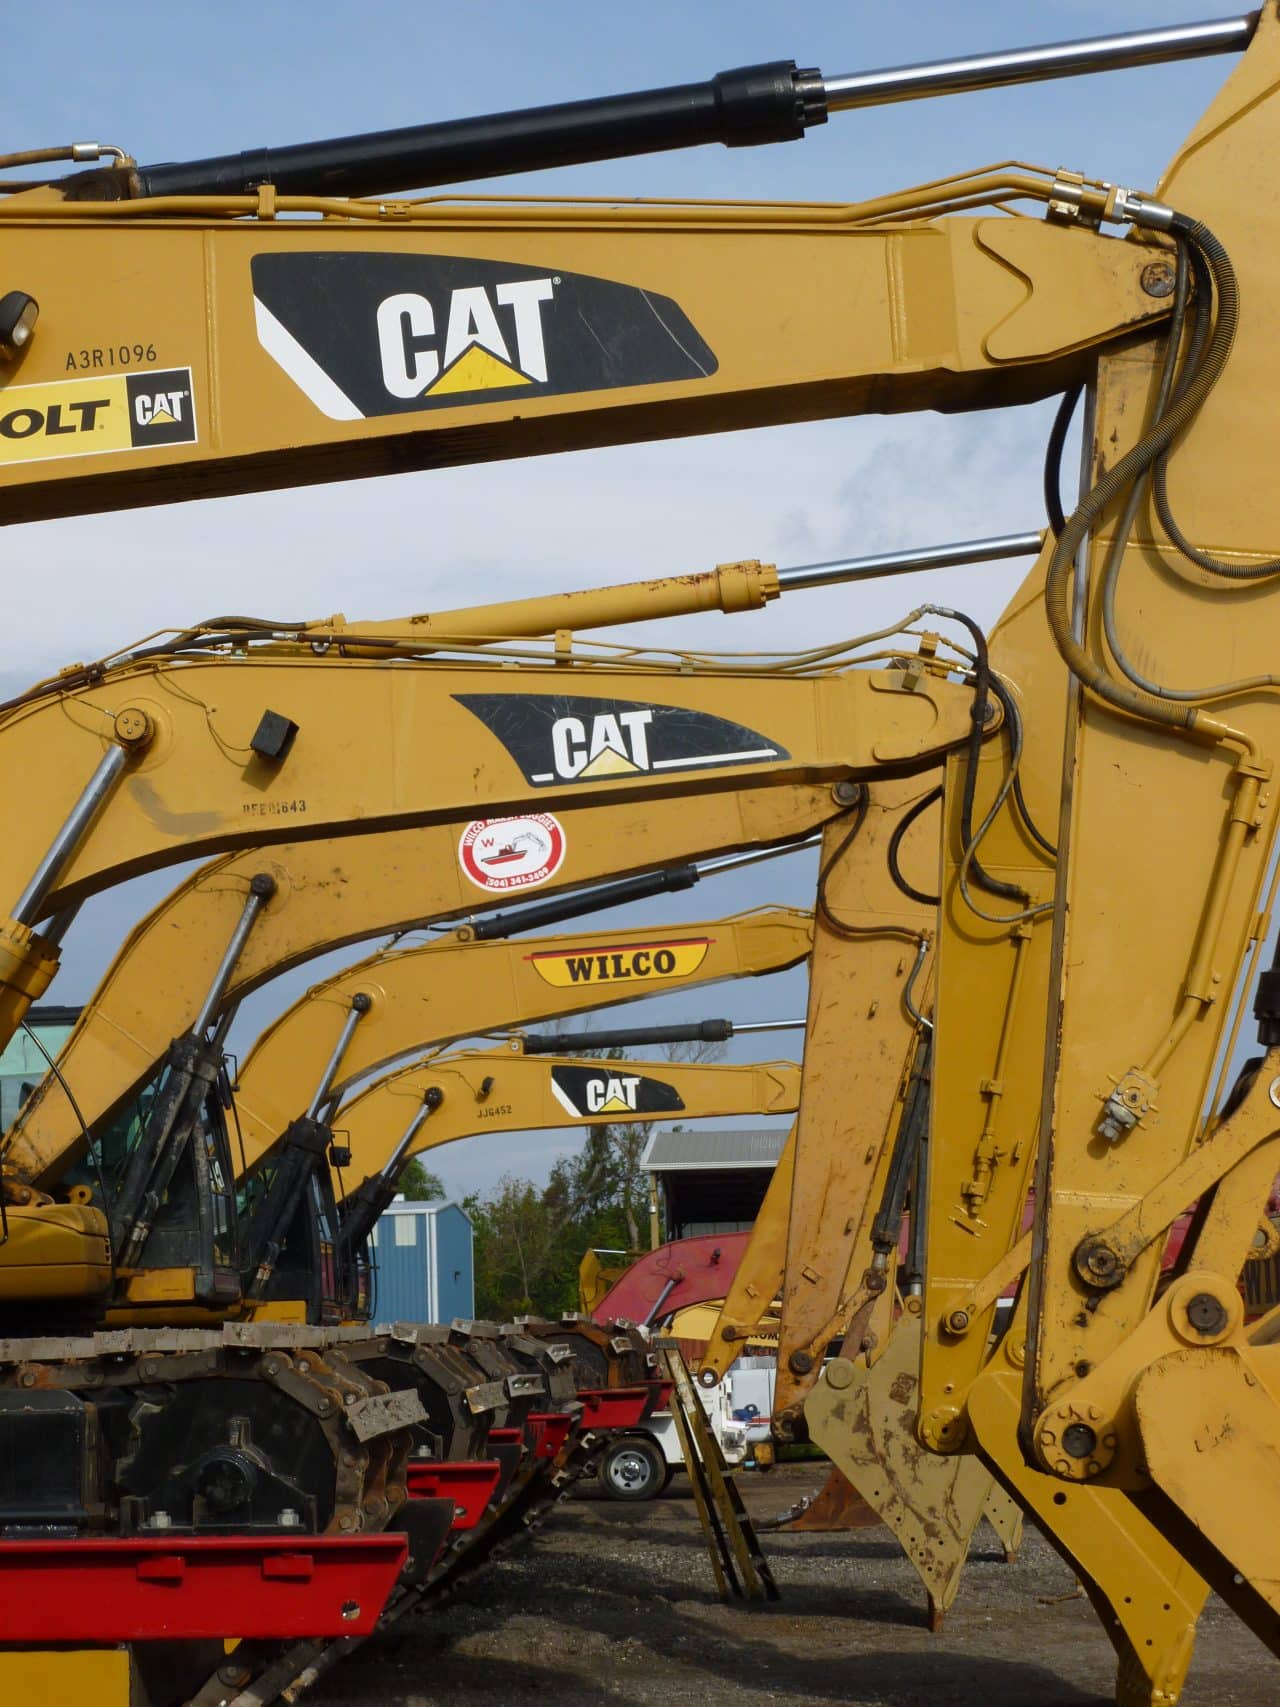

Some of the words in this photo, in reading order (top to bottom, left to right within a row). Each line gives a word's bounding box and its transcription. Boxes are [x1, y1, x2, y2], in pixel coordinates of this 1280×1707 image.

[376, 278, 555, 399] CAT
[66, 344, 157, 371] A3R1096
[135, 391, 184, 426] CAT
[551, 710, 653, 779] CAT
[463, 820, 486, 847] WILCO
[481, 837, 495, 848] W
[566, 949, 676, 982] WILCO
[586, 1077, 641, 1112] CAT
